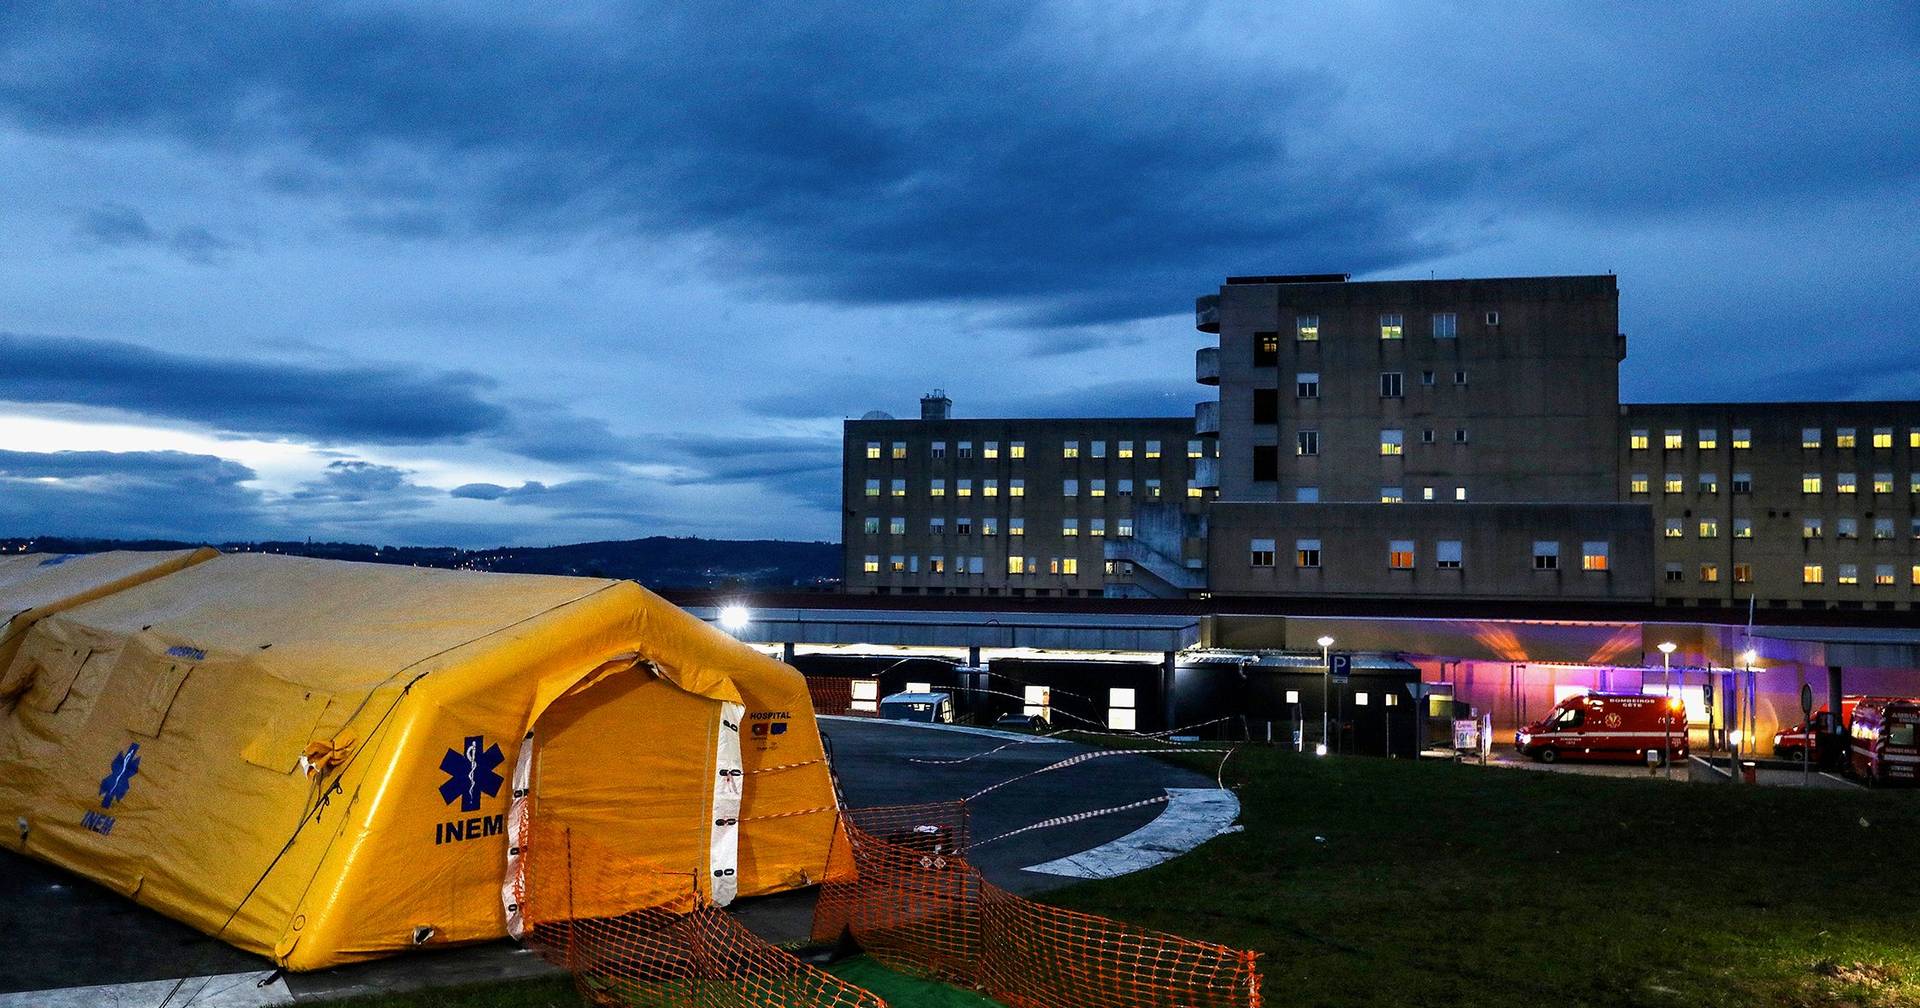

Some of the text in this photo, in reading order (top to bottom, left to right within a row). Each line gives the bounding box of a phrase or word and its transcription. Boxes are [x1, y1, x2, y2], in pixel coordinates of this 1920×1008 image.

[1334, 655, 1347, 674] P
[750, 711, 791, 720] HOSPITAL
[80, 809, 116, 836] INEM
[435, 814, 504, 845] INEM
